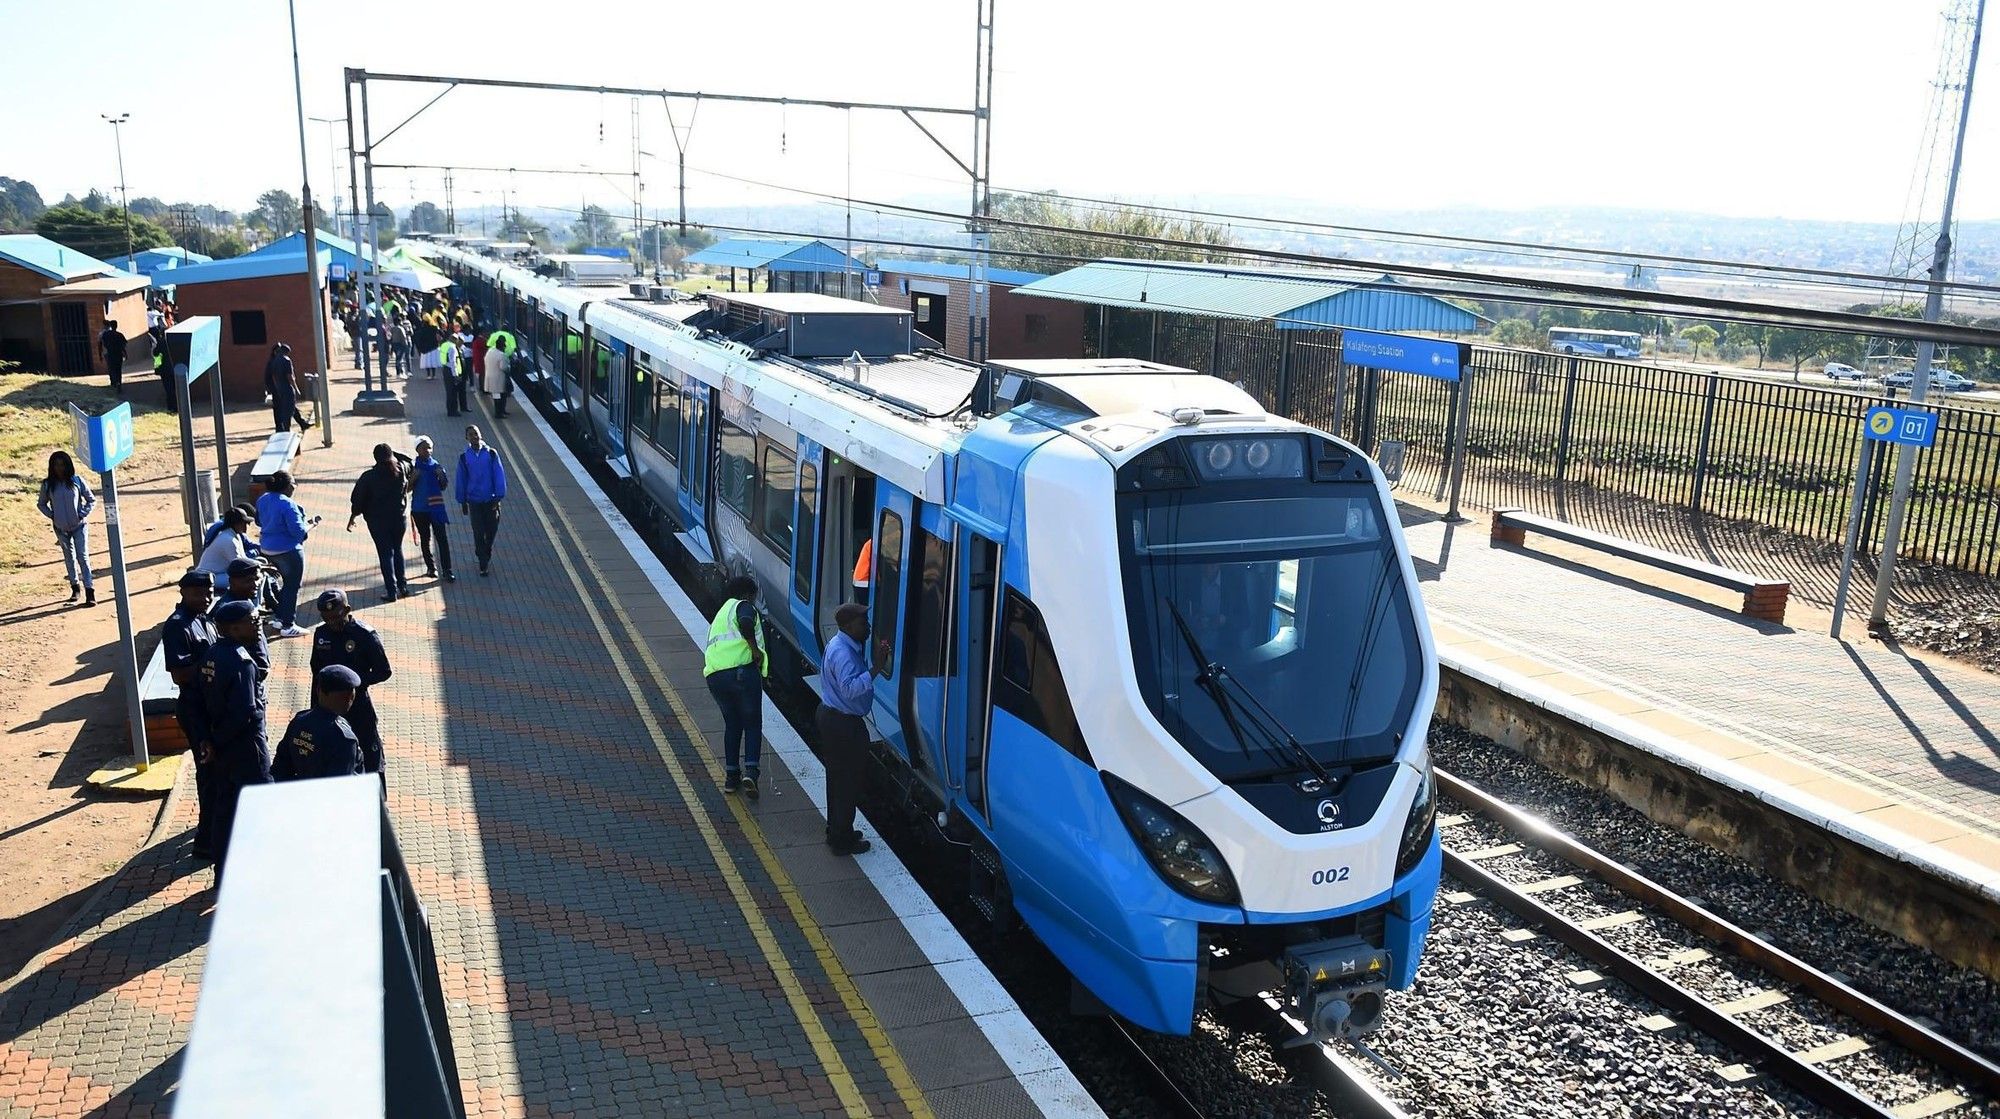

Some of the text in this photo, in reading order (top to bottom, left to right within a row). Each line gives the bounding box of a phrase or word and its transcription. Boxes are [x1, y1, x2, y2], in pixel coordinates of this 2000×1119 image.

[1346, 339, 1404, 357] Kalafong Station
[1906, 422, 1922, 436] 01
[1320, 823, 1343, 831] ALSTOM
[1312, 867, 1350, 885] 002
